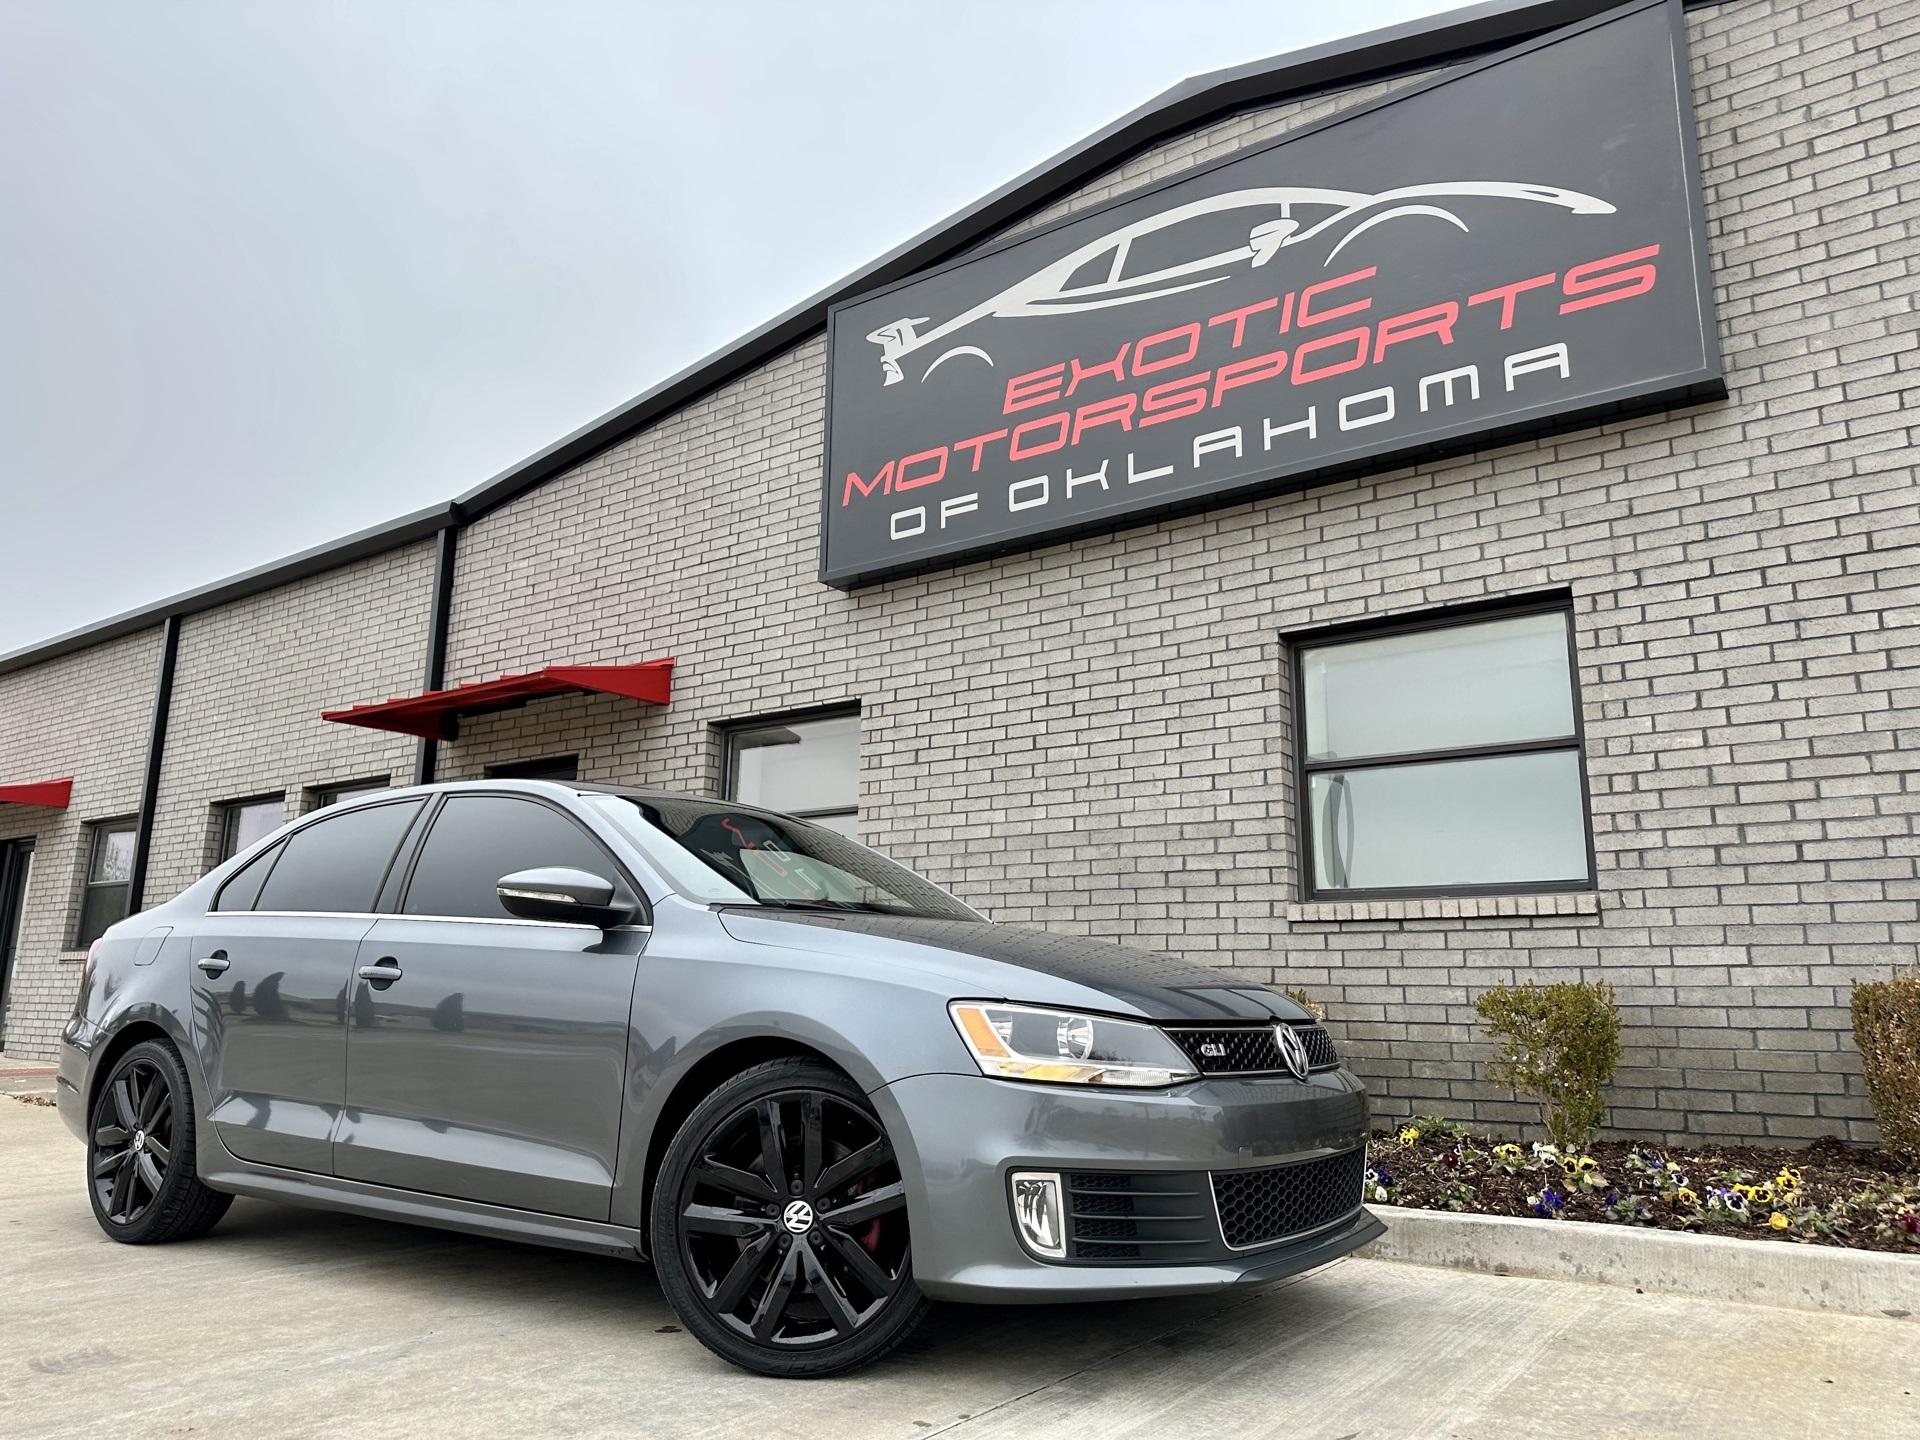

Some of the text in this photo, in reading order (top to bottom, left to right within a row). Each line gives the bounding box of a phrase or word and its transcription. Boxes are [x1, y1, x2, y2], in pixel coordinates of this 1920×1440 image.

[843, 244, 1660, 506] MOTORSPORTS
[1003, 267, 1377, 415] EXOTIC
[890, 343, 1571, 541] OF OKLAHOMA
